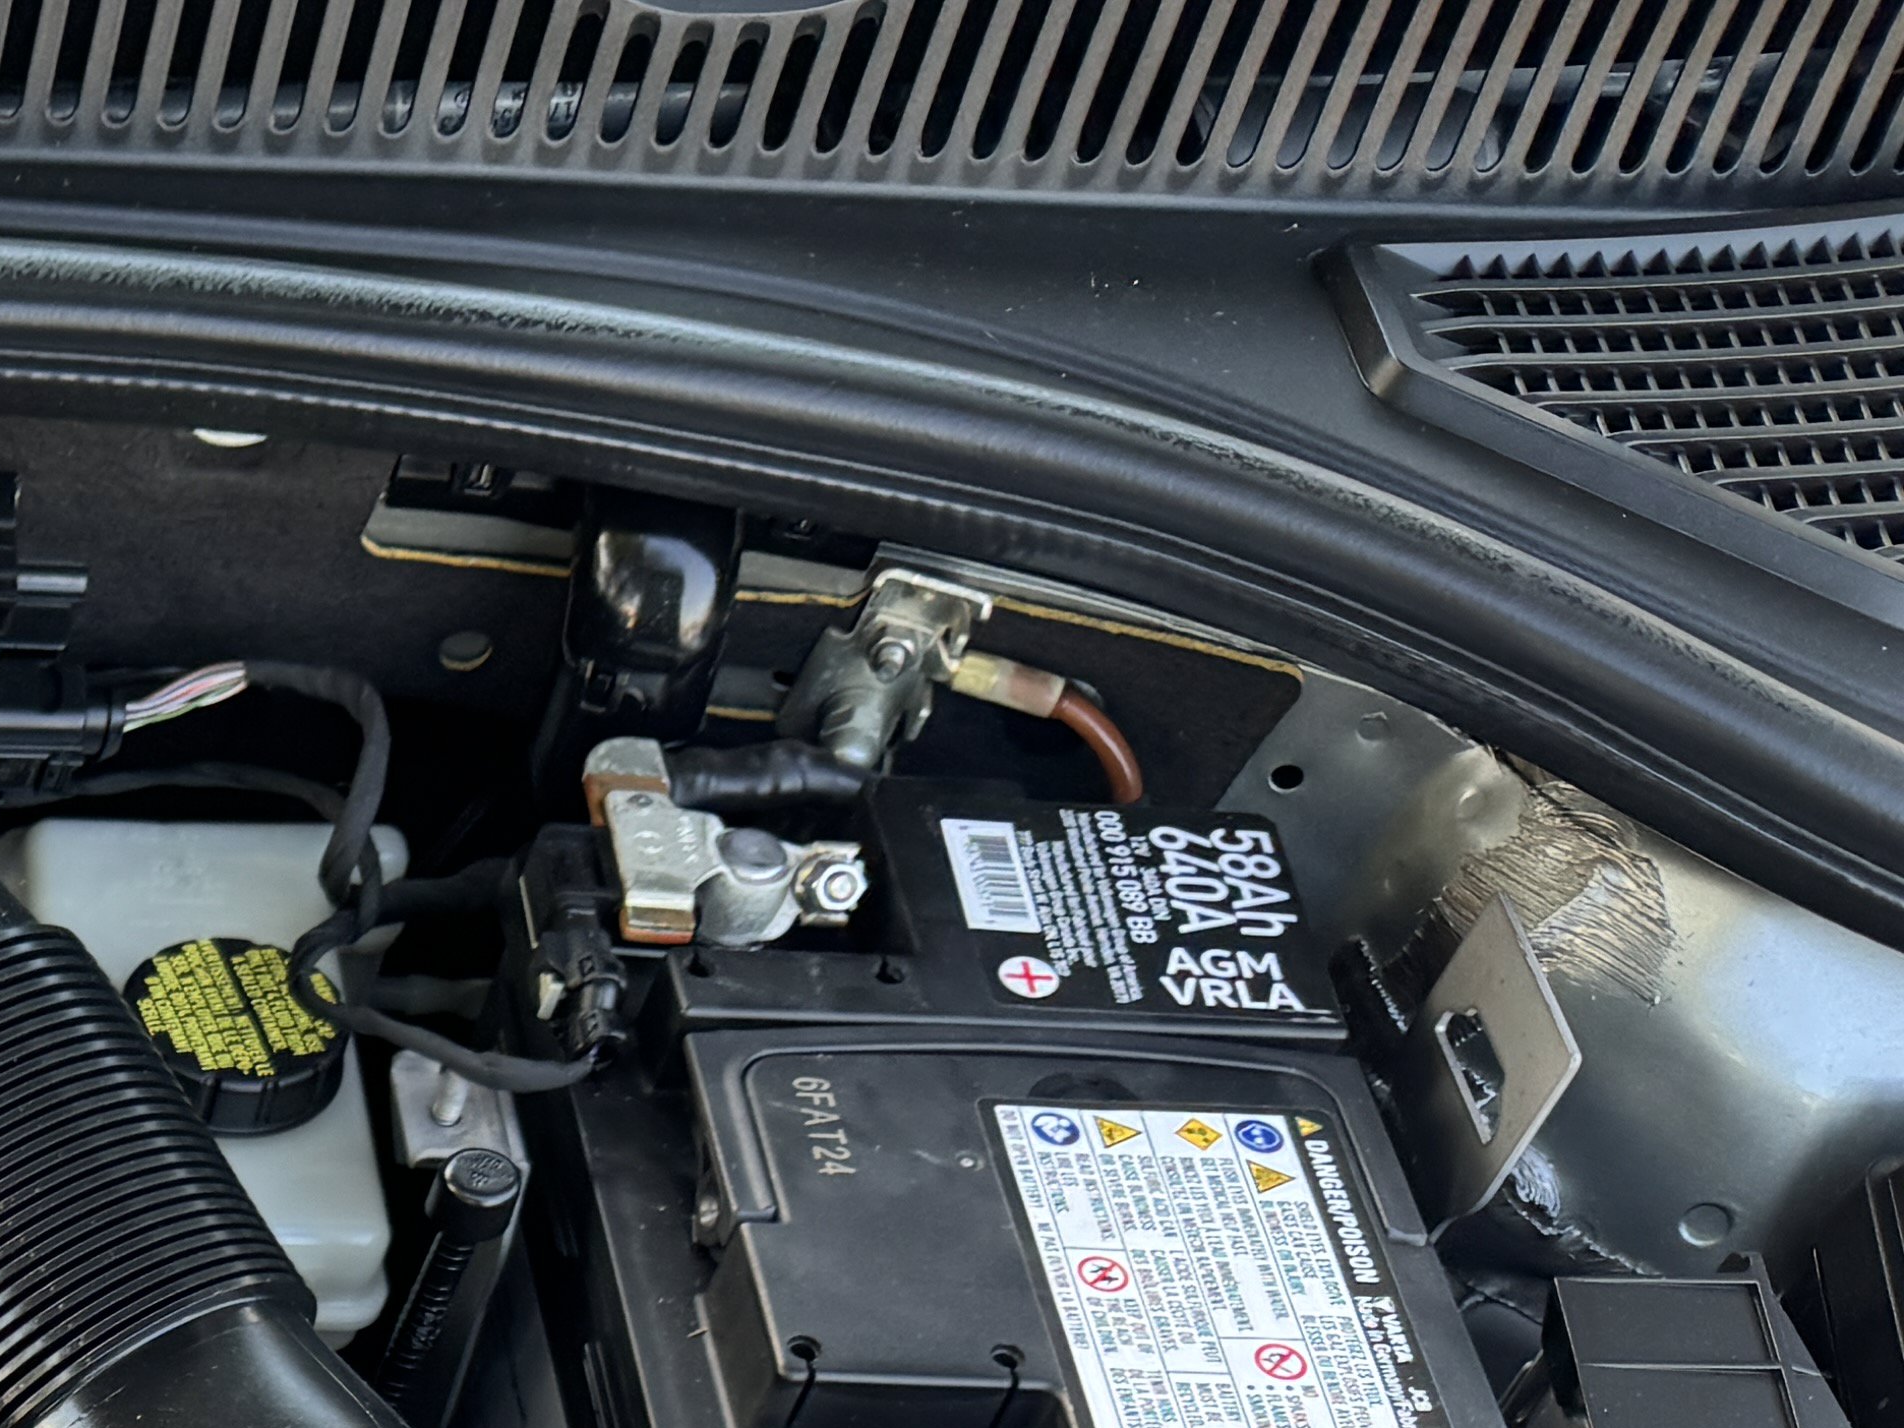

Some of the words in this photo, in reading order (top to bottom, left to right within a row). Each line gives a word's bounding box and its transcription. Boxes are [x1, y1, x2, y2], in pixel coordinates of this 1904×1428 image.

[1093, 810, 1127, 842] 000
[1103, 844, 1137, 876] 915
[1128, 835, 1151, 856] 12V
[1148, 897, 1171, 920] DIN
[1146, 825, 1241, 936] 640A
[1206, 827, 1304, 938] 58Ah
[1125, 915, 1160, 944] BB
[1160, 946, 1285, 980] AGM
[1158, 975, 1306, 1011] VRLA
[790, 1070, 857, 1181] 6FAT24
[1301, 1139, 1380, 1282] DANGER/POISON
[1317, 1315, 1338, 1329] LES
[1352, 1295, 1383, 1328] Made
[1379, 1313, 1415, 1363] VARTA
[1353, 1363, 1373, 1378] LES
[1194, 1382, 1219, 1408] MUST
[1214, 1383, 1243, 1422] BATTERY
[1299, 1385, 1319, 1397] NO
[1204, 1412, 1224, 1423] BE
[1264, 1394, 1292, 1428] FLAMES
